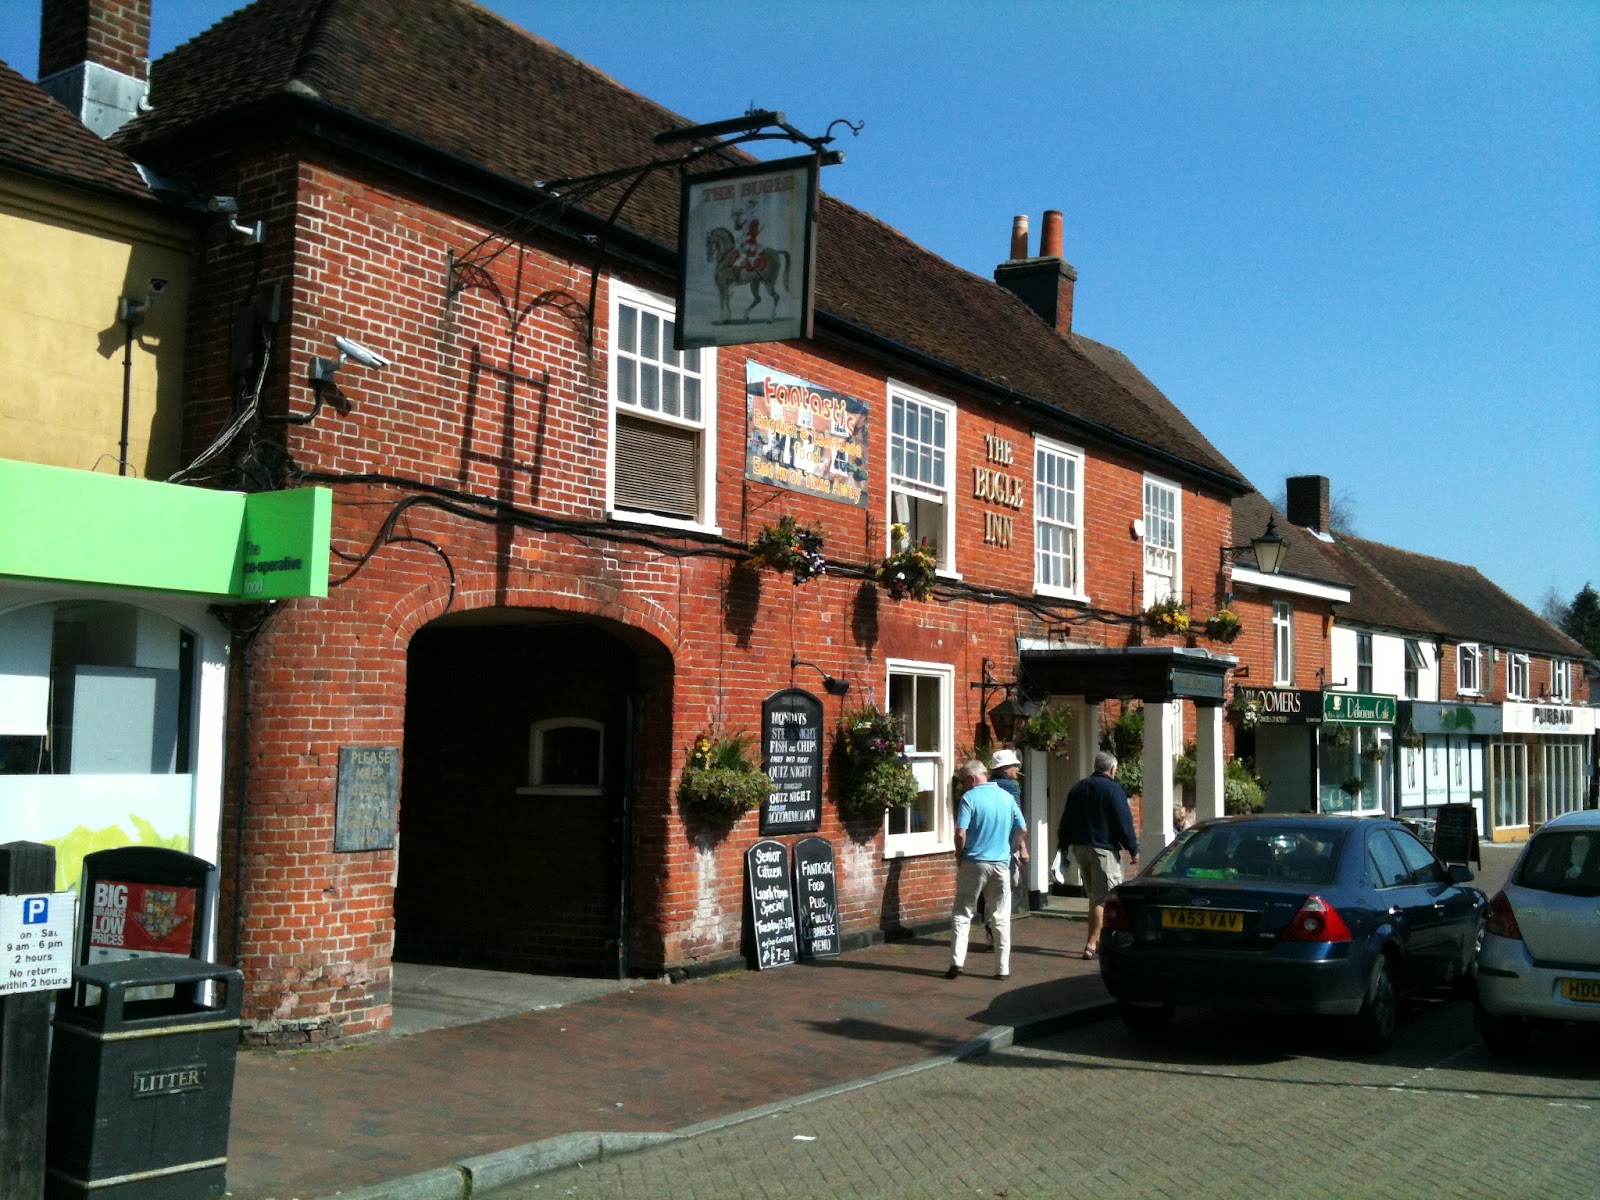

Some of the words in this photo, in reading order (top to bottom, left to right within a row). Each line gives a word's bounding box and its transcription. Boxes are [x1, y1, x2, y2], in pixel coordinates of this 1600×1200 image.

[764, 376, 856, 435] Fantastic
[985, 433, 1014, 465] THE
[971, 464, 1025, 508] BUGLE
[985, 510, 1014, 546] INN
[769, 741, 788, 754] FISH
[797, 740, 817, 753] CHIPS
[351, 751, 391, 765] PLEASE
[768, 766, 788, 781] QUIZ
[789, 765, 812, 778] NIGHT
[769, 793, 788, 804] QUIZ
[789, 790, 811, 803] NIGHT
[755, 848, 782, 864] Senior
[757, 865, 782, 879] Citizen
[94, 883, 128, 908] BIG
[93, 905, 127, 917] BRANDS
[760, 901, 785, 917] Special
[92, 915, 126, 935] LOW
[1168, 910, 1205, 926] YA53
[1209, 914, 1238, 928] VAV
[7, 943, 13, 951] 9
[39, 941, 45, 949] 6
[48, 941, 63, 951] pm
[91, 931, 125, 946] PRICES
[15, 955, 21, 963] 2
[25, 954, 53, 963] hours
[9, 969, 23, 978] No
[27, 967, 58, 977] return
[0, 980, 28, 990] within
[31, 979, 37, 988] 2
[39, 976, 68, 987] hours
[138, 1070, 200, 1093] LITTER
